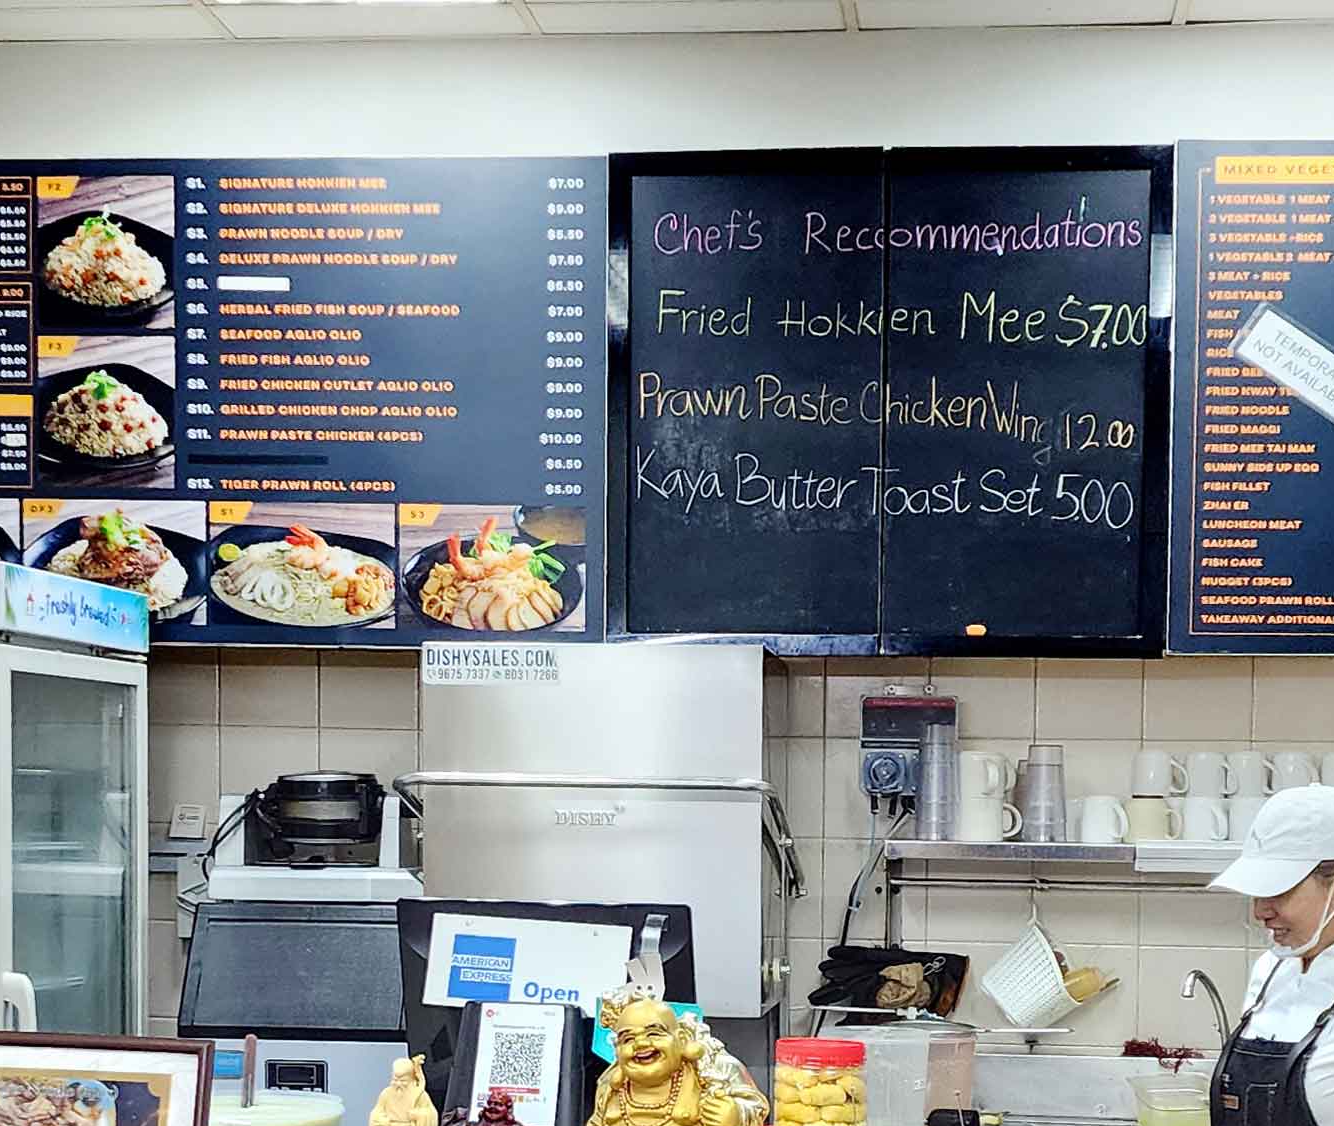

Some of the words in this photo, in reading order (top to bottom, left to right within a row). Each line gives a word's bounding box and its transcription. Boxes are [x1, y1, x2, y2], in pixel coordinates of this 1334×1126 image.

[1223, 164, 1277, 176] MIXED
[653, 210, 763, 255] Chef's
[657, 289, 752, 336] Fried
[778, 300, 935, 337] Hokkien
[960, 291, 1045, 343] Mee
[1055, 294, 1148, 350] $7.00
[1253, 338, 1285, 364] NOT
[638, 372, 752, 422] Prawn
[754, 374, 852, 425] Paste
[860, 377, 988, 431] Chicken
[635, 445, 725, 514] Kaya
[735, 453, 858, 512] Butter
[861, 466, 971, 517] Toast
[979, 469, 1044, 517] Set
[426, 649, 558, 667] DISHYSALES.COM
[451, 955, 510, 968] AMERICAN
[462, 969, 513, 983] EXPRESS
[523, 981, 580, 1004] Open
